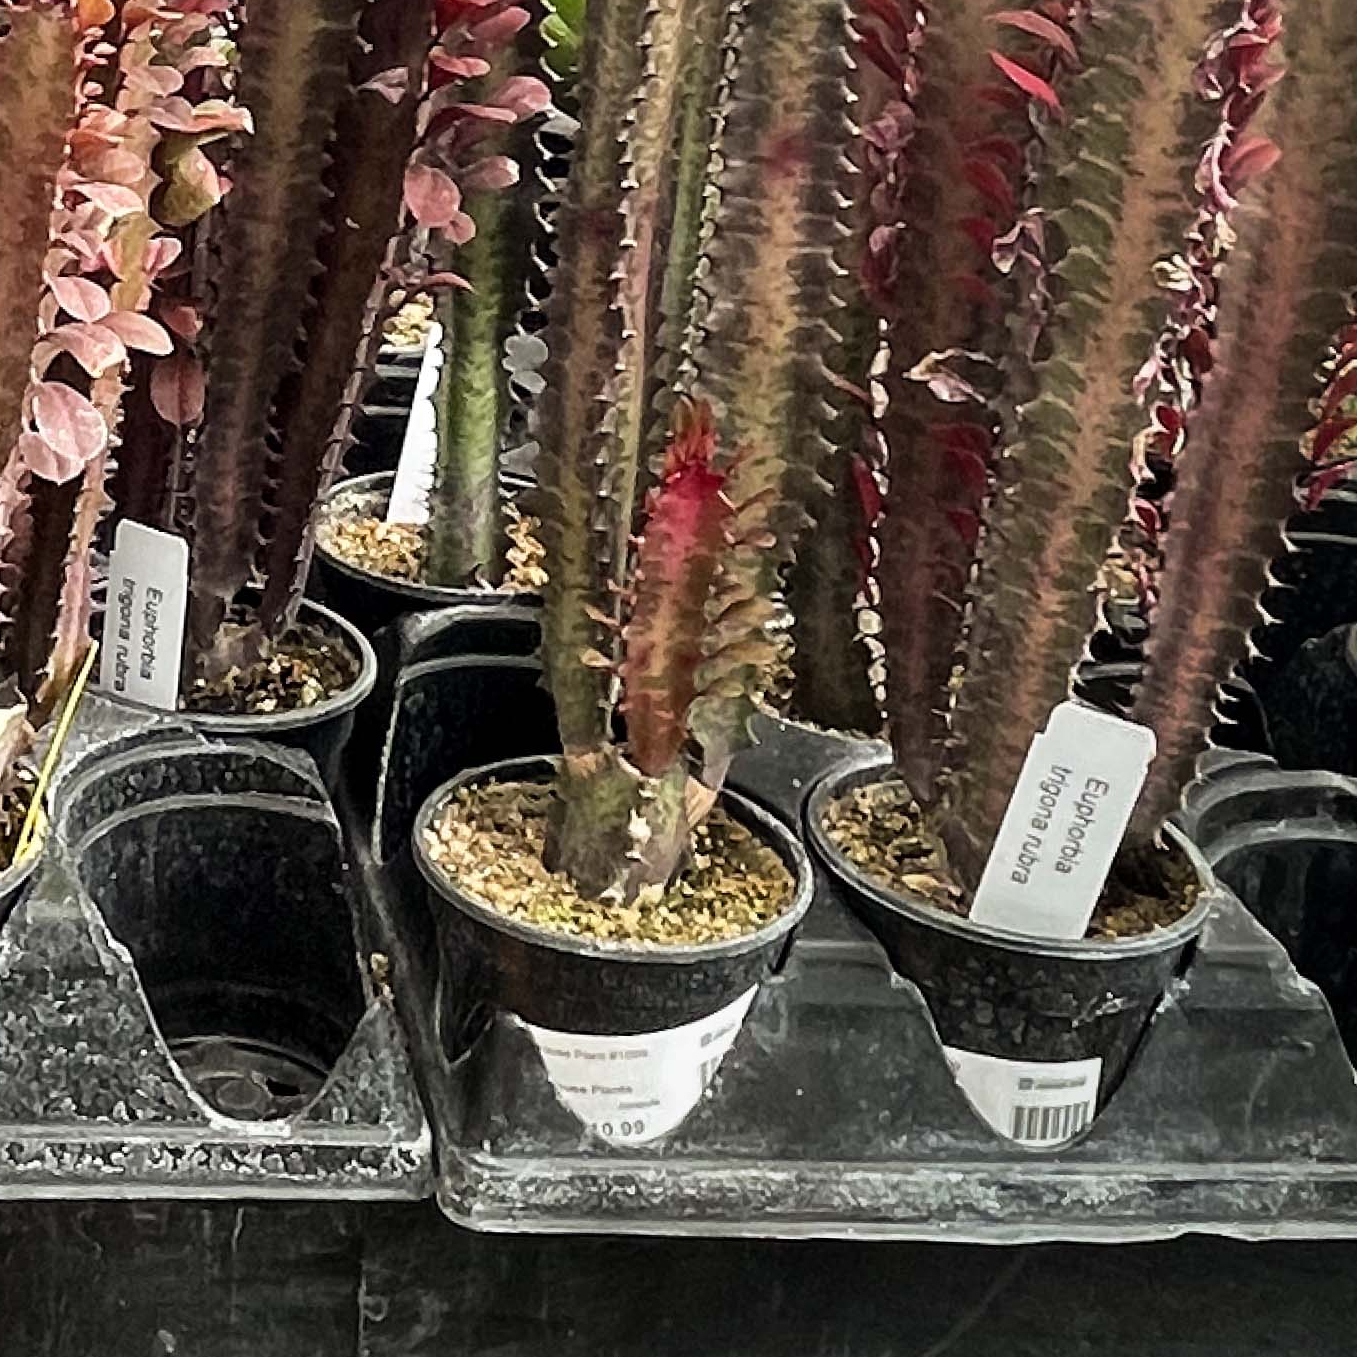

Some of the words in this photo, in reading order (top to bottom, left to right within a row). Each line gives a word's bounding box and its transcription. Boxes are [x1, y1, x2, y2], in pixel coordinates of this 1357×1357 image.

[140, 587, 163, 680] Euphorbia
[114, 644, 130, 692] rubra
[1031, 764, 1073, 831] trigona
[1055, 777, 1110, 874] Euphorbia
[1010, 833, 1042, 884] rubra
